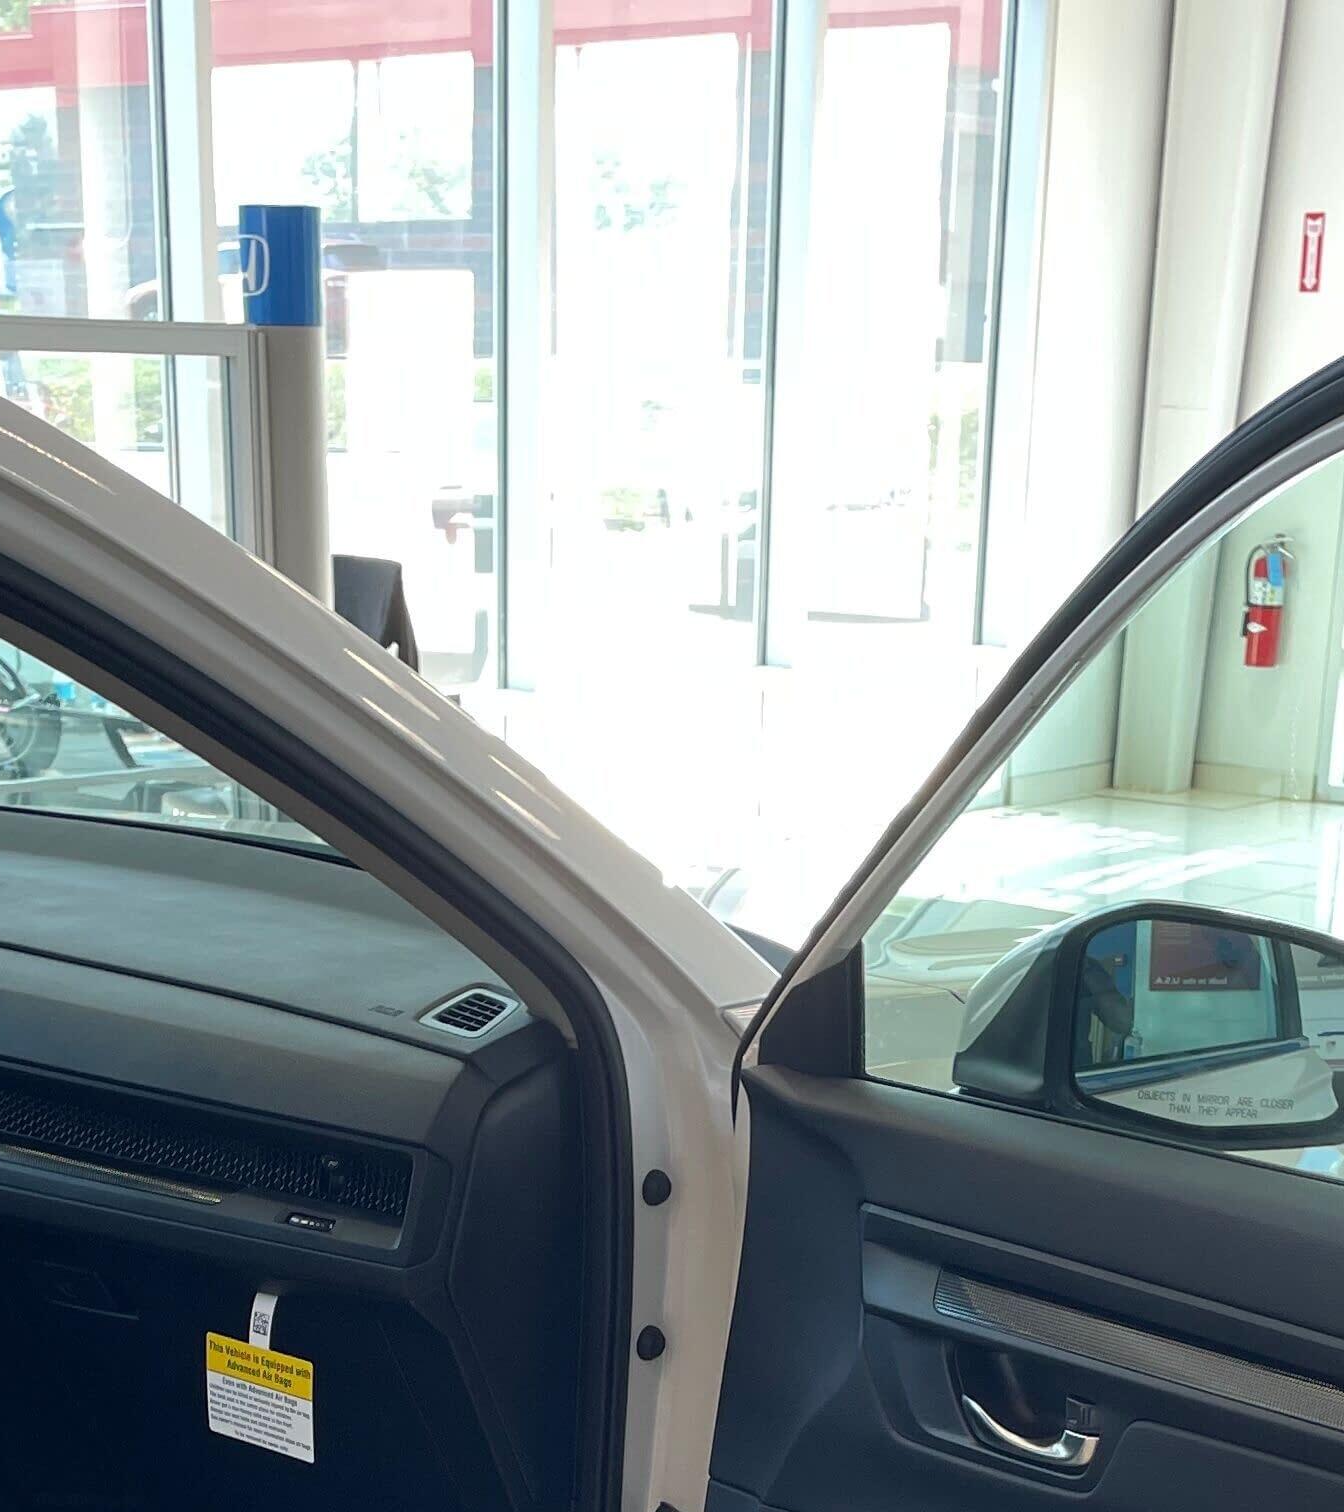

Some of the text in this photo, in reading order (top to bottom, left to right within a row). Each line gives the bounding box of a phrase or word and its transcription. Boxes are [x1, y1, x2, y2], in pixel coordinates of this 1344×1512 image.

[1137, 1089, 1295, 1111] OBJECTS IN MIRROR ARE CLOSER
[1169, 1102, 1257, 1119] THAN THEY APPEAR
[209, 1339, 311, 1380] This Vehicle is Equipped with
[227, 1359, 292, 1388] Advanced Air Bags
[248, 1384, 274, 1399] Advanced
[275, 1392, 283, 1402] Air
[284, 1395, 298, 1408] Bags
